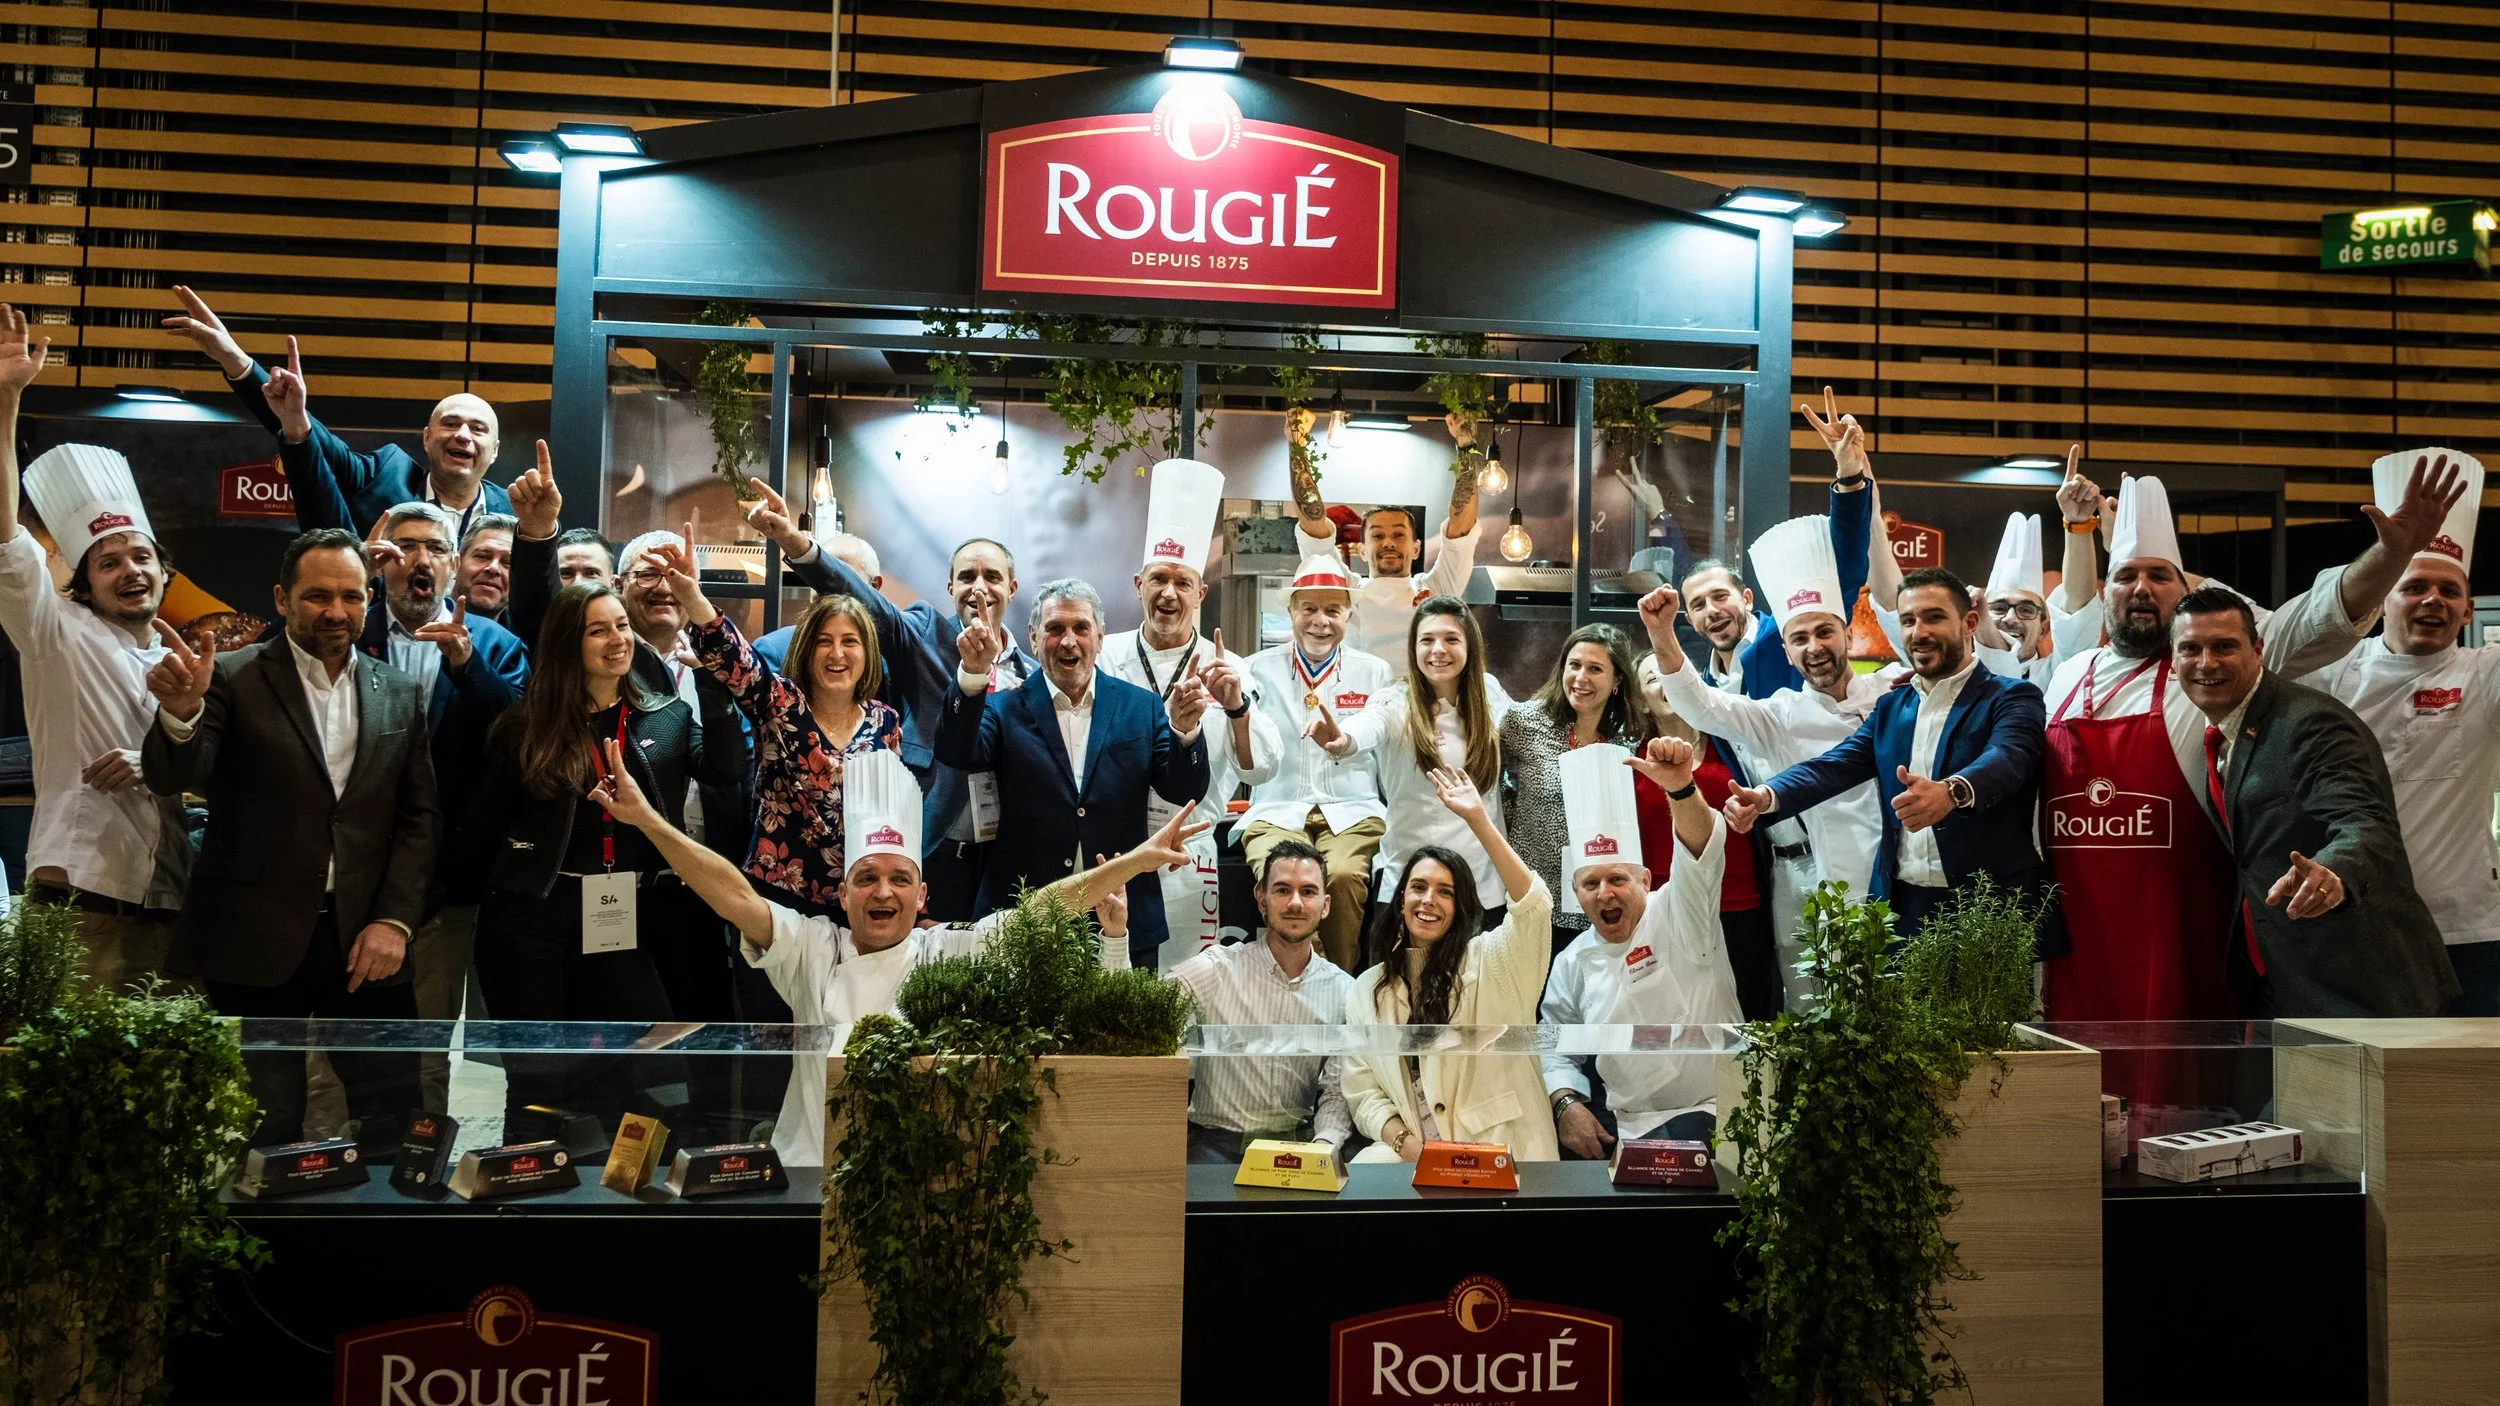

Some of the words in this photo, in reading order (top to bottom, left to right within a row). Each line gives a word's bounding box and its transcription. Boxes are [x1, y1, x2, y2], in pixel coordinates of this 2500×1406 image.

[1044, 162, 1338, 248] ROUGIÉ
[2350, 213, 2447, 242] Sortie
[1131, 251, 1201, 268] DEPUIS
[1208, 255, 1249, 271] 1875
[2338, 243, 2364, 264] de
[2371, 238, 2459, 261] secours
[236, 475, 294, 501] ROU
[2053, 804, 2154, 836] ROUGIÉ
[1192, 854, 1218, 953] UGIÉ
[380, 1342, 610, 1406] ROUGIÉ
[1371, 1327, 1579, 1397] ROUGIÉ
